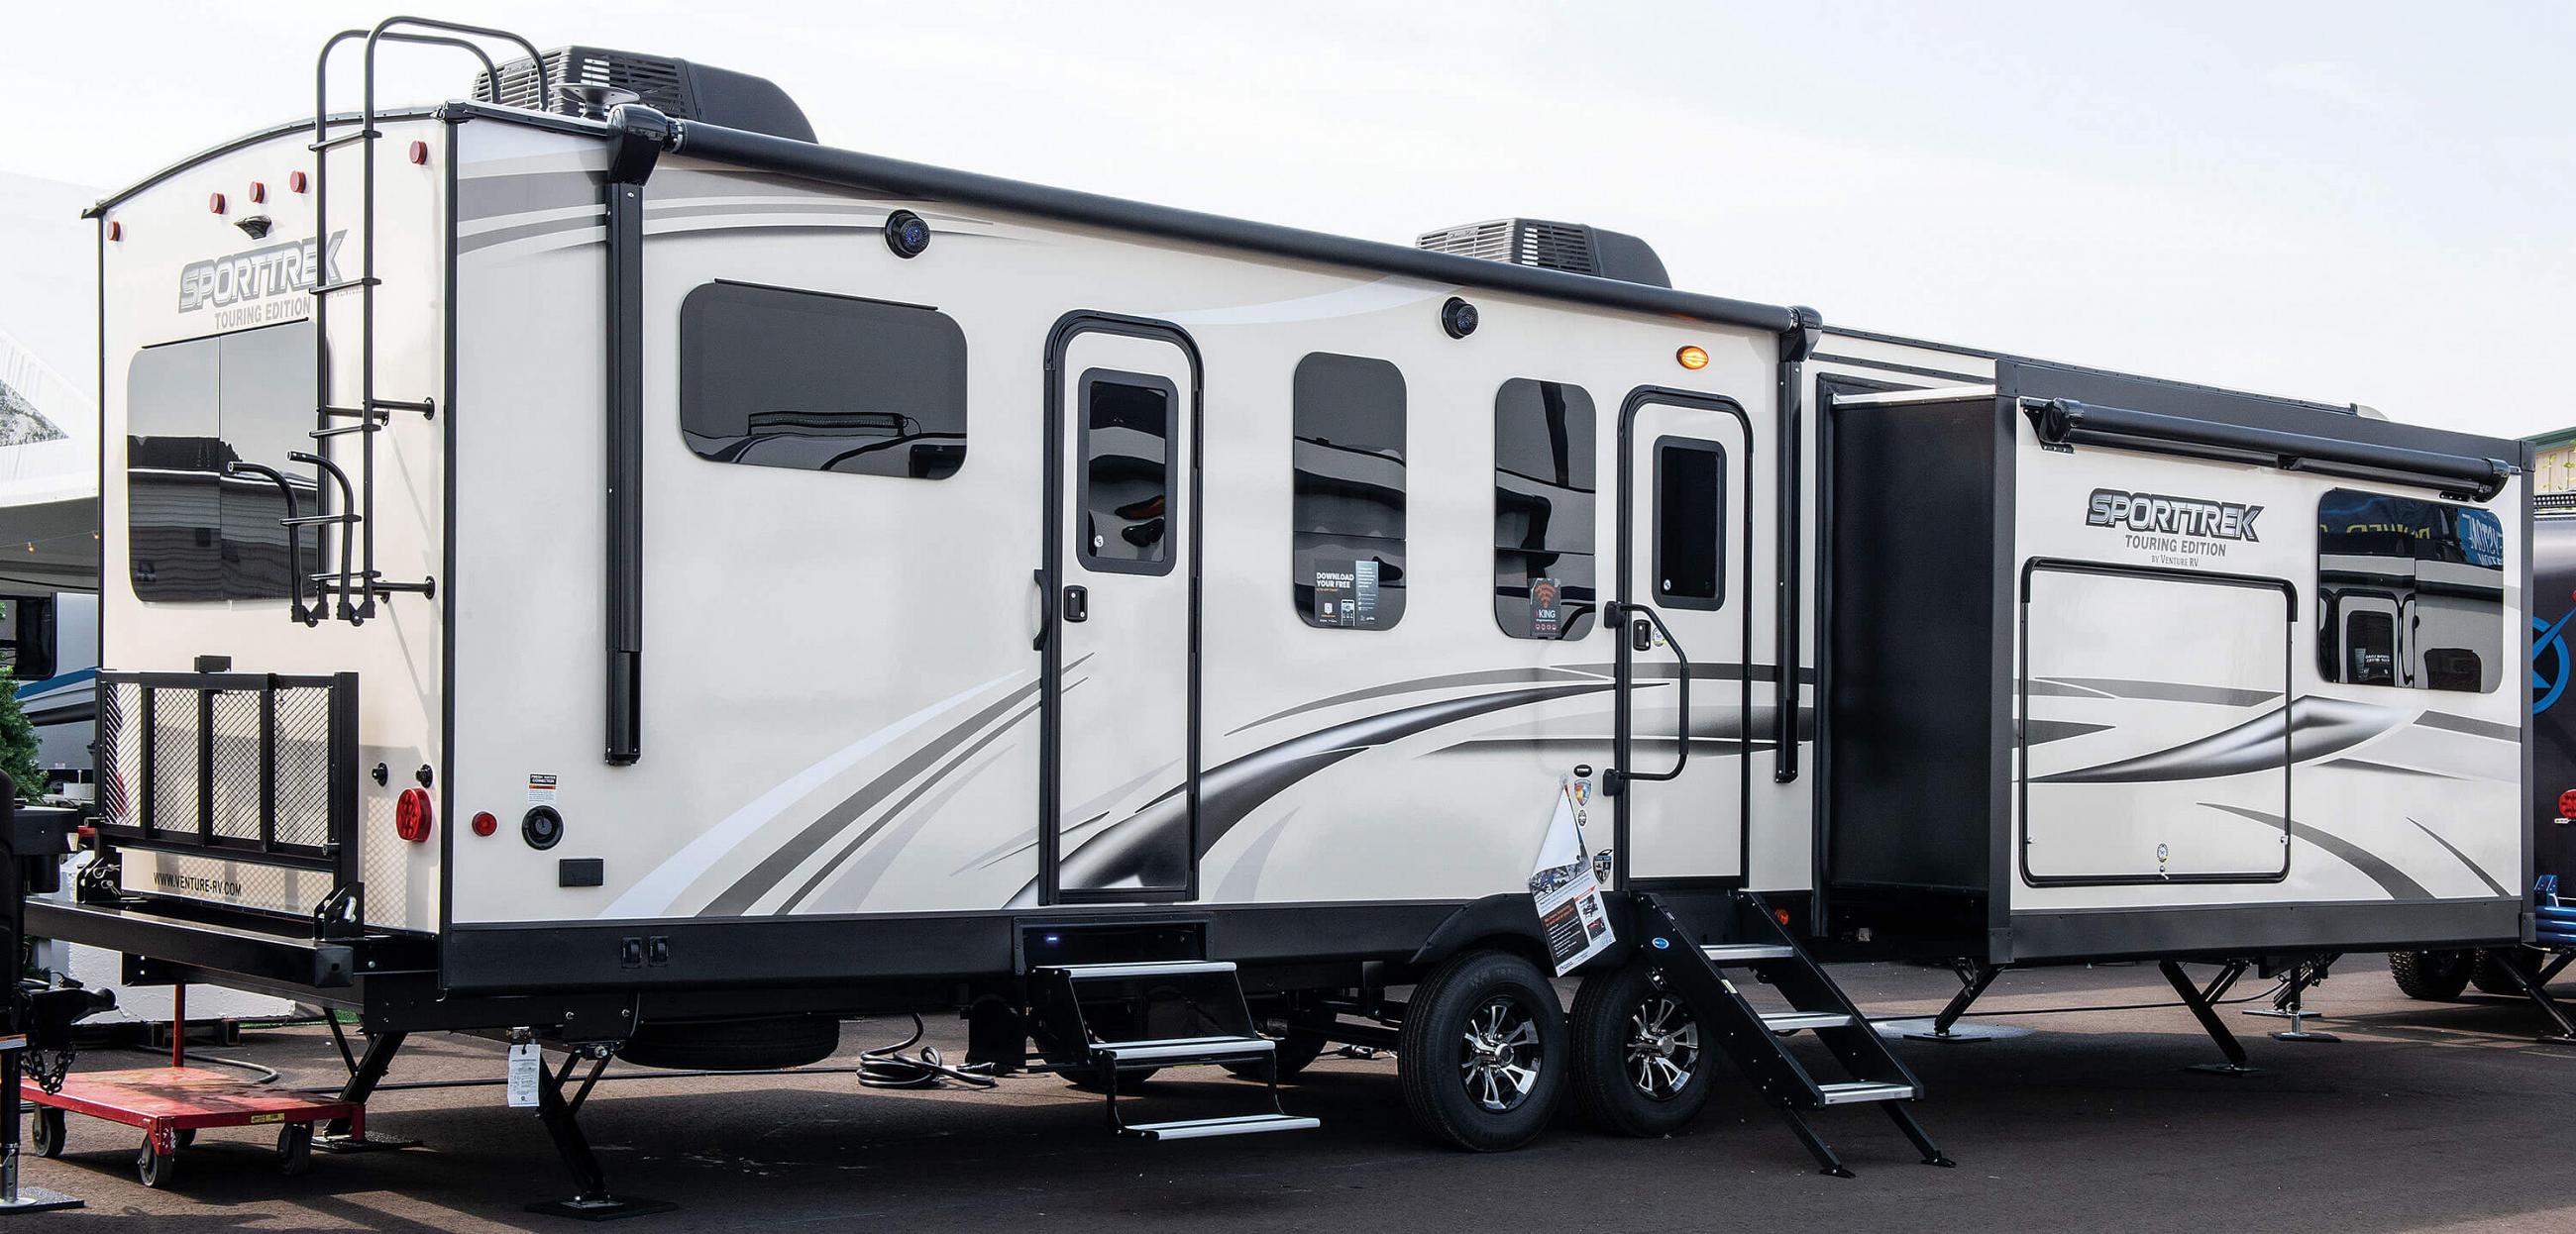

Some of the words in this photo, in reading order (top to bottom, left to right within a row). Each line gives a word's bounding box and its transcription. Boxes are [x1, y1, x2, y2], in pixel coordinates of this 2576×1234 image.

[178, 230, 348, 313] SPORTTREK
[215, 304, 263, 330] TOURING
[266, 296, 311, 324] EDITION
[2086, 488, 2265, 543] SPORTTREK
[2125, 535, 2178, 553] TOURING
[2181, 540, 2226, 557] EDITION
[2160, 554, 2189, 566] VENTURE
[2189, 557, 2200, 567] RV
[1316, 572, 1354, 581] DOWNLOAD
[1538, 609, 1556, 618] KING
[154, 873, 242, 897] WWW.VENTURE-RV.COM
